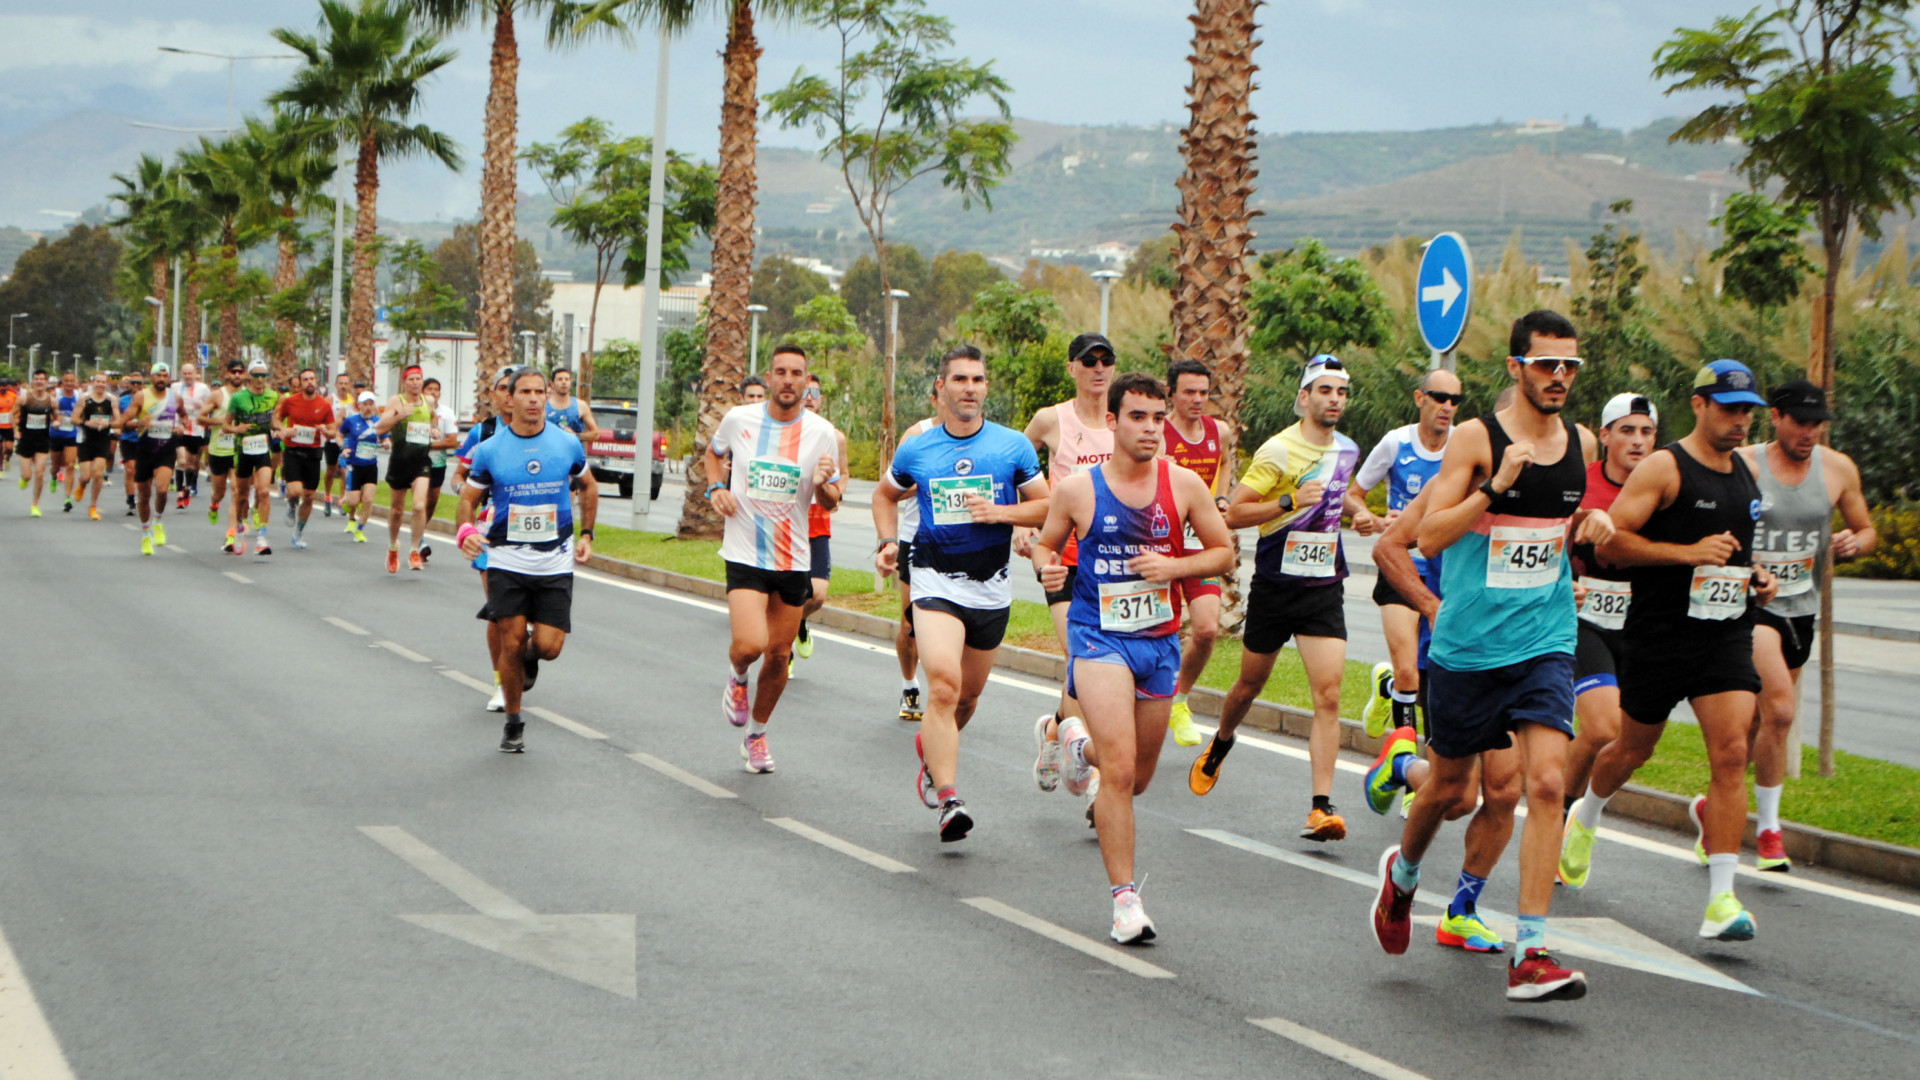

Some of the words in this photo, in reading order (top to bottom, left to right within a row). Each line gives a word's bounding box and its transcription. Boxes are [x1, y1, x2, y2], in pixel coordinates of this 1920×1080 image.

[760, 474, 787, 488] 1309
[524, 517, 541, 531] 66
[1098, 544, 1122, 554] CLUB
[1124, 544, 1172, 554] ATLTISMO
[1299, 545, 1327, 563] 346
[1511, 544, 1550, 568] 454
[1769, 563, 1799, 582] 543
[1709, 581, 1740, 604] 252
[1119, 594, 1152, 619] 371
[1592, 594, 1625, 613] 382
